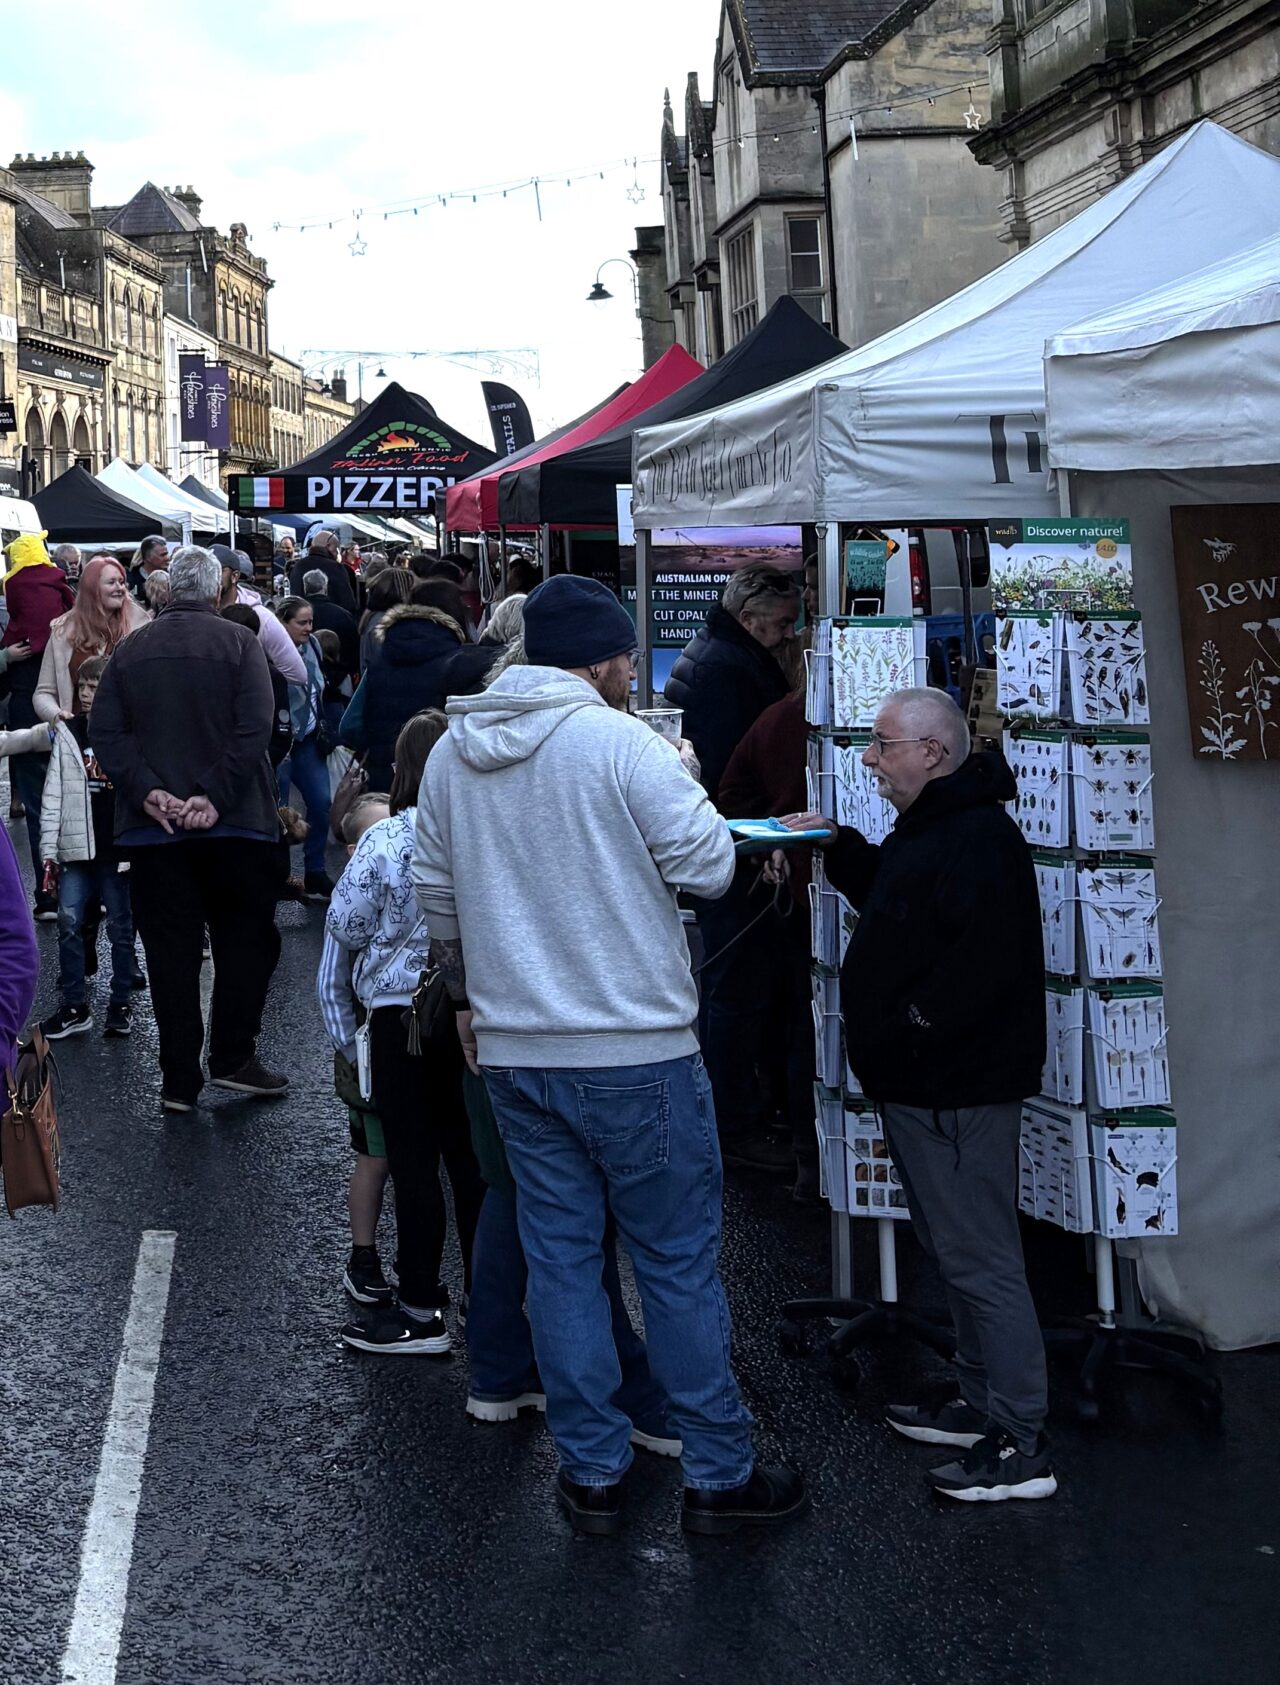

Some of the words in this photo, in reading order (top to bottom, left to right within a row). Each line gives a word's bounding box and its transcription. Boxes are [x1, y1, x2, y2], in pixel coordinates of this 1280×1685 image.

[411, 450, 470, 464] Food
[1027, 526, 1076, 537] Discover
[1079, 526, 1123, 537] nature!
[656, 574, 711, 583] AUSTRALIAN
[659, 590, 680, 600] THE
[683, 590, 719, 600] MINER
[654, 610, 674, 620] CUT
